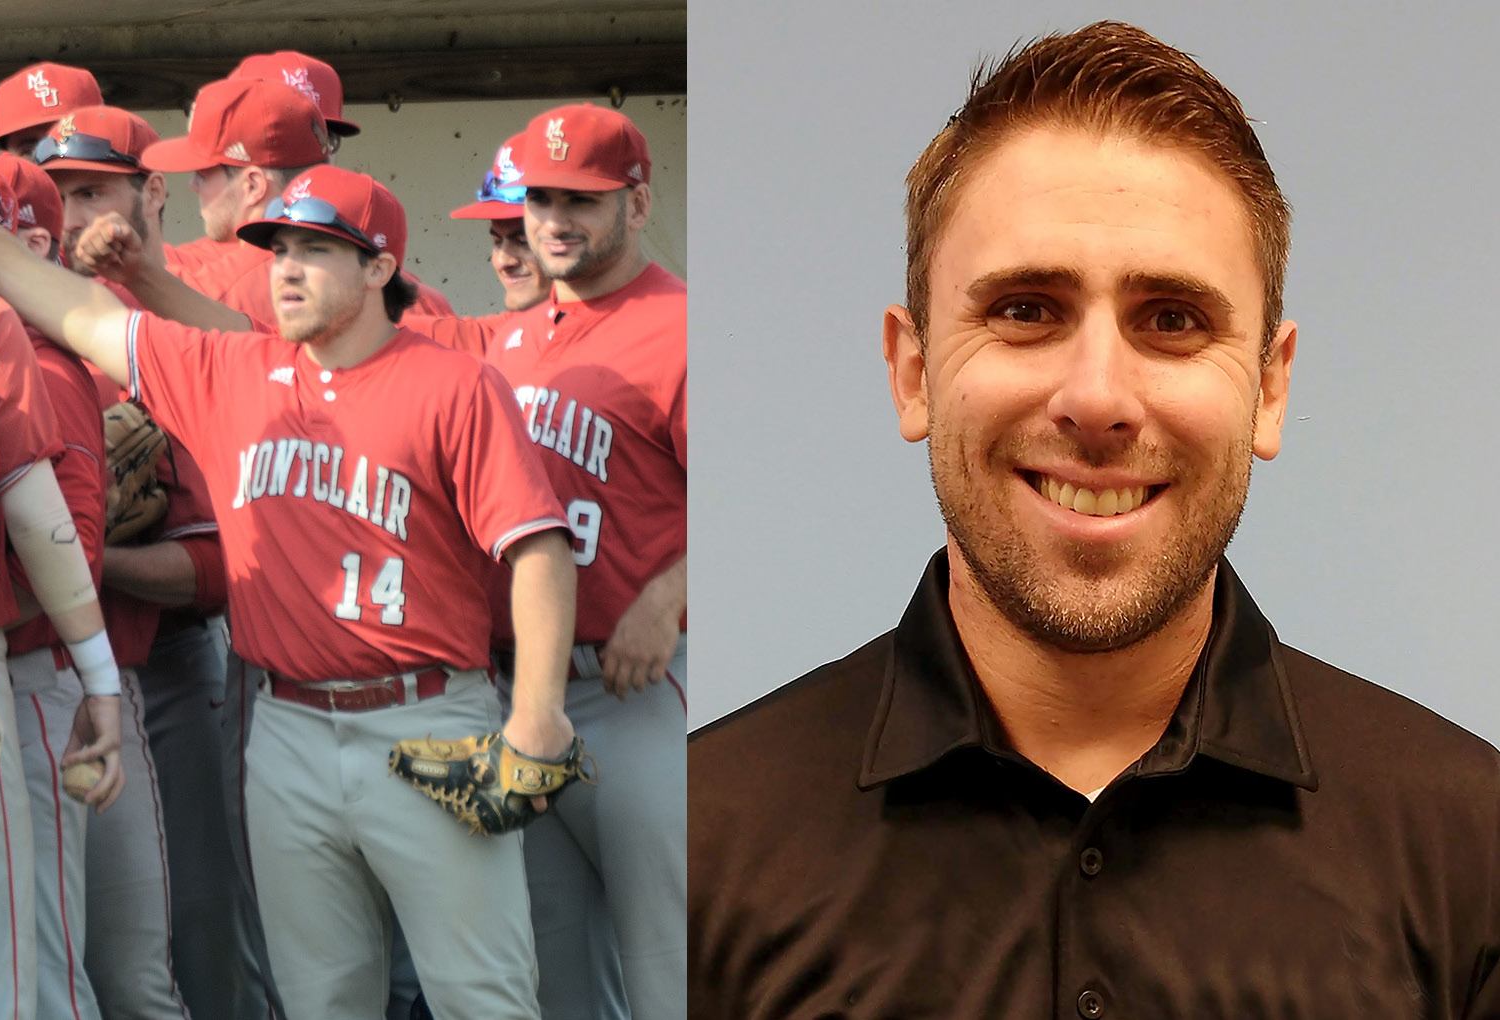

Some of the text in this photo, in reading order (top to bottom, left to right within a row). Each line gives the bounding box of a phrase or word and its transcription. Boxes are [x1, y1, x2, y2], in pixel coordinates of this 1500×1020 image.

[26, 70, 60, 108] MSU
[546, 117, 570, 162] MSU
[512, 385, 614, 485] TCLAIR
[232, 437, 412, 543] MONTCLAIR
[334, 550, 406, 627] 14
